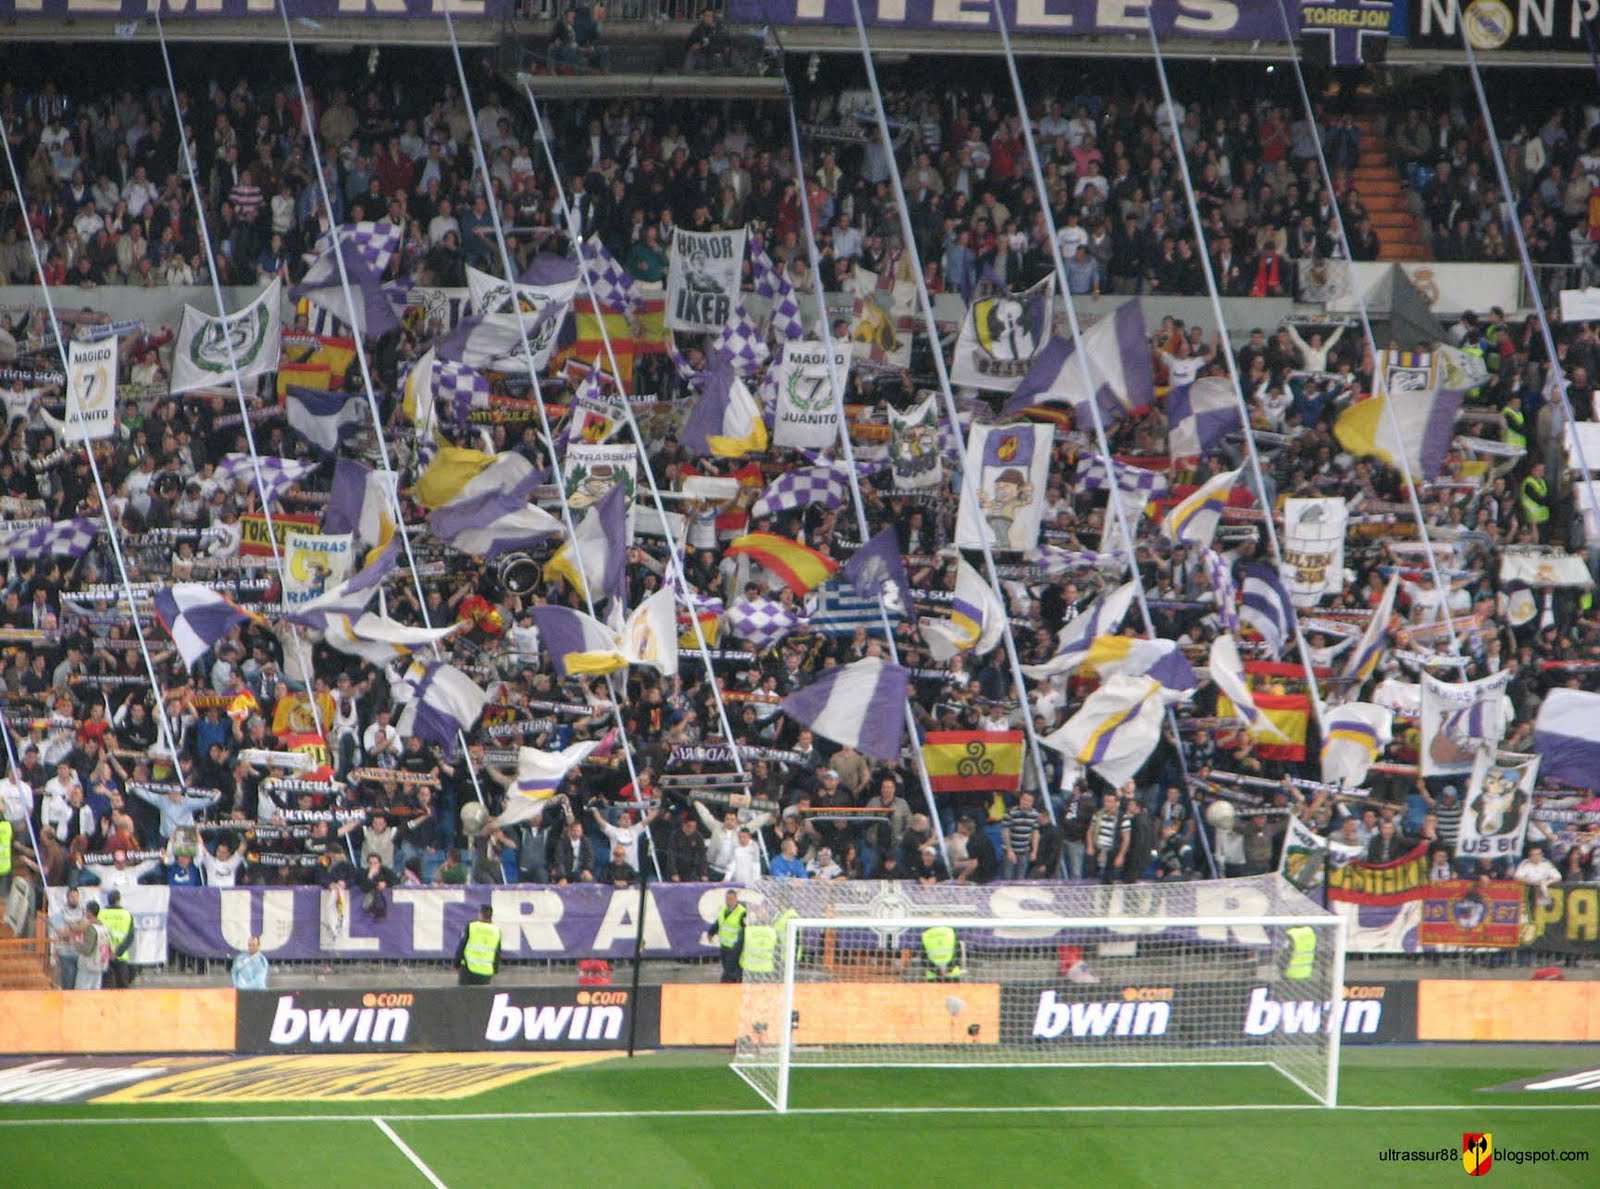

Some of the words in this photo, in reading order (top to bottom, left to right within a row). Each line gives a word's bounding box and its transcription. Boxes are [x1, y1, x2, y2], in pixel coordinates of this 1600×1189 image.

[1304, 7, 1389, 27] TORREJON
[677, 233, 733, 259] HONOR
[676, 287, 730, 326] IKER
[74, 349, 111, 363] MAGICO
[789, 352, 844, 365] MAGIO
[83, 374, 95, 398] 7
[804, 378, 825, 399] 7
[69, 409, 108, 423] JUANITO
[781, 412, 838, 424] JUANITO
[292, 538, 347, 552] ULTRAS
[280, 809, 333, 820] ULTRAS
[336, 809, 365, 820] SUR
[1463, 837, 1490, 853] US
[270, 994, 410, 1044] bwin
[486, 993, 623, 1043] bwin
[1033, 990, 1172, 1038] bwin
